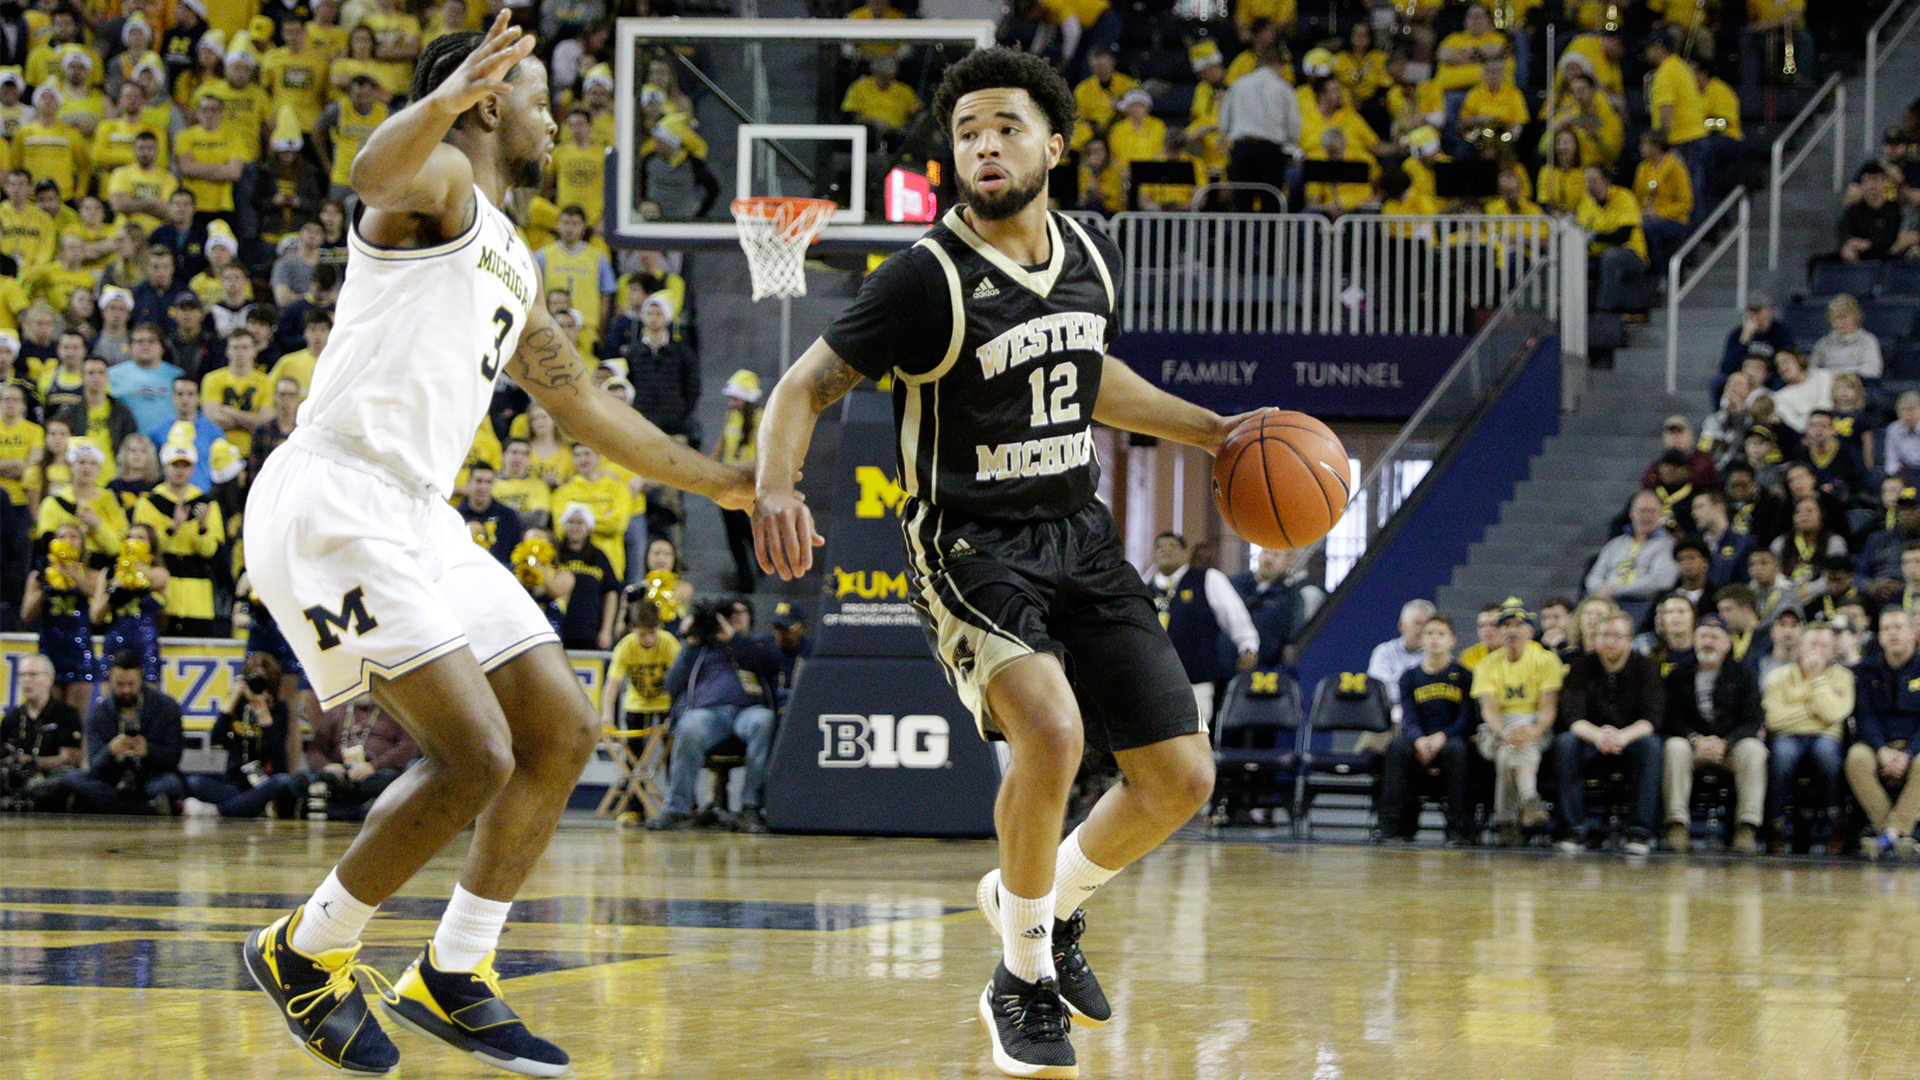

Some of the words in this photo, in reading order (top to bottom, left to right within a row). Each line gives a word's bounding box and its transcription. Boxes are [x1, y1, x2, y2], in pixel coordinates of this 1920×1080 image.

[477, 245, 532, 314] MICHIGA
[973, 288, 1000, 299] adidas
[481, 304, 514, 383] 3
[1028, 361, 1080, 427] 12
[1161, 359, 1259, 385] FAMILY
[1292, 361, 1404, 387] TUNNEL
[855, 465, 912, 519] M
[302, 584, 380, 652] M
[1251, 671, 1279, 694] M
[1339, 671, 1368, 694] M
